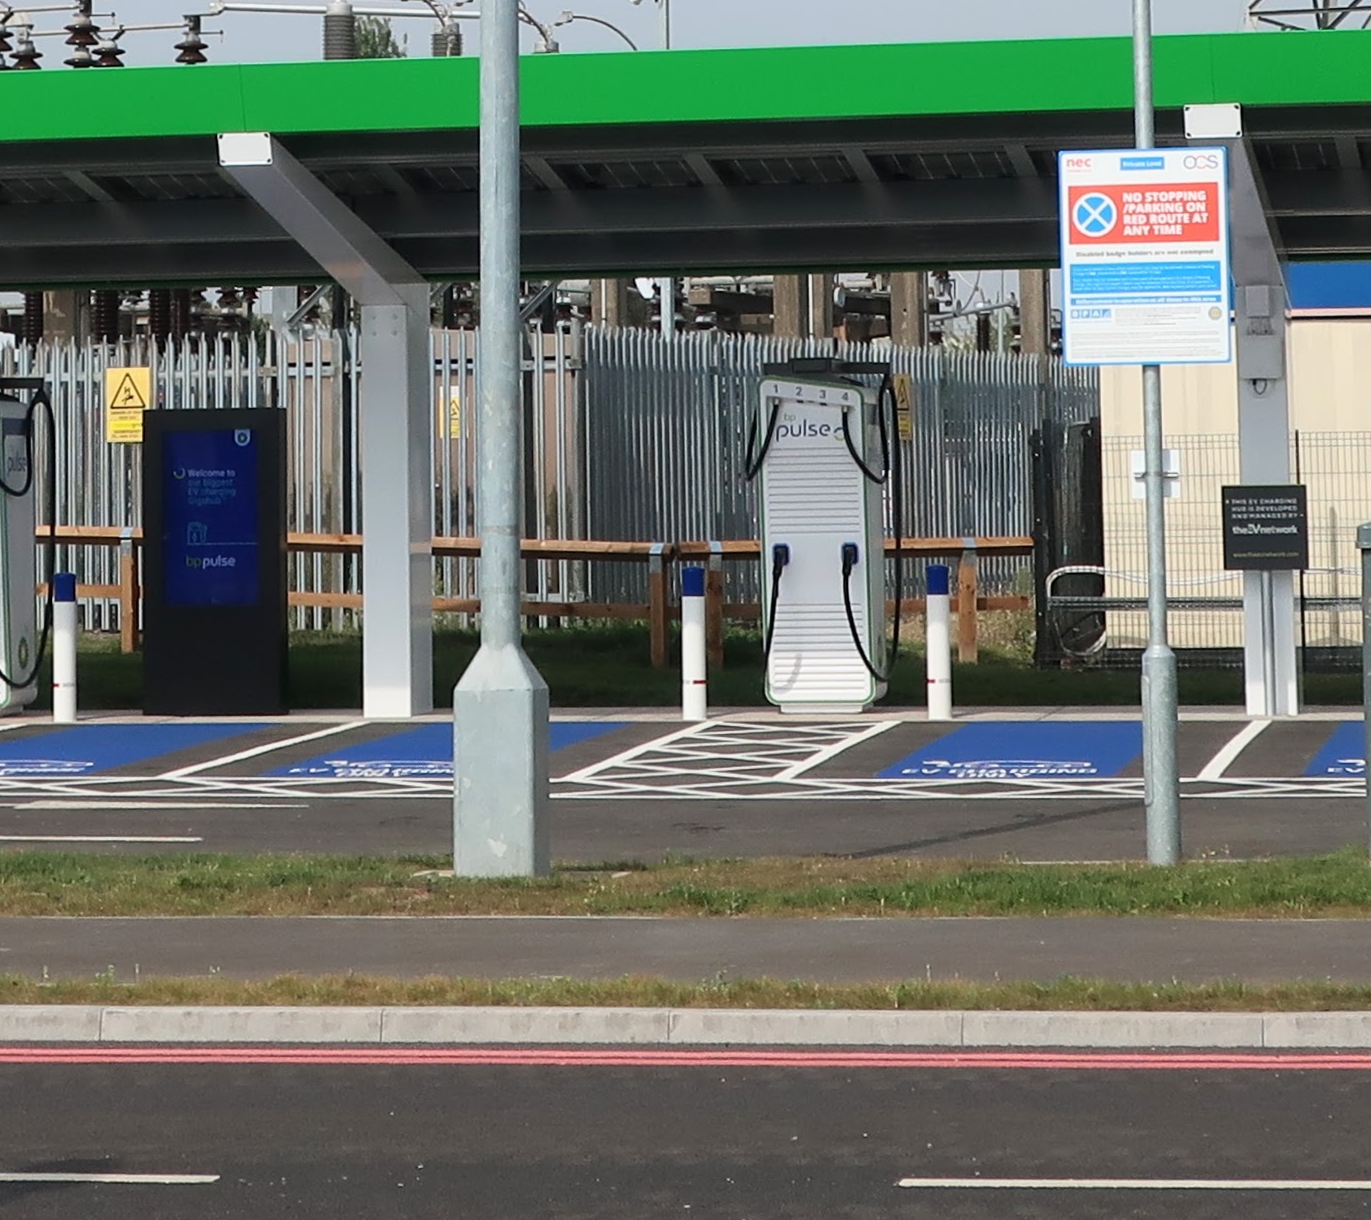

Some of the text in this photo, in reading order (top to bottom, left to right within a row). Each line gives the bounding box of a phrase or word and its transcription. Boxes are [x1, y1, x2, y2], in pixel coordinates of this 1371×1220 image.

[1066, 158, 1092, 168] nec
[1183, 155, 1219, 170] OCS
[1122, 190, 1207, 203] NO STOPPING
[1123, 202, 1206, 214] /PARKING ON
[1123, 212, 1209, 225] RED ROUTE AT
[1123, 225, 1183, 236] ANY TIME
[773, 384, 849, 401] 1 2 3 4
[776, 418, 832, 442] pulse
[188, 468, 236, 478] Welcome to
[202, 554, 236, 570] pulse
